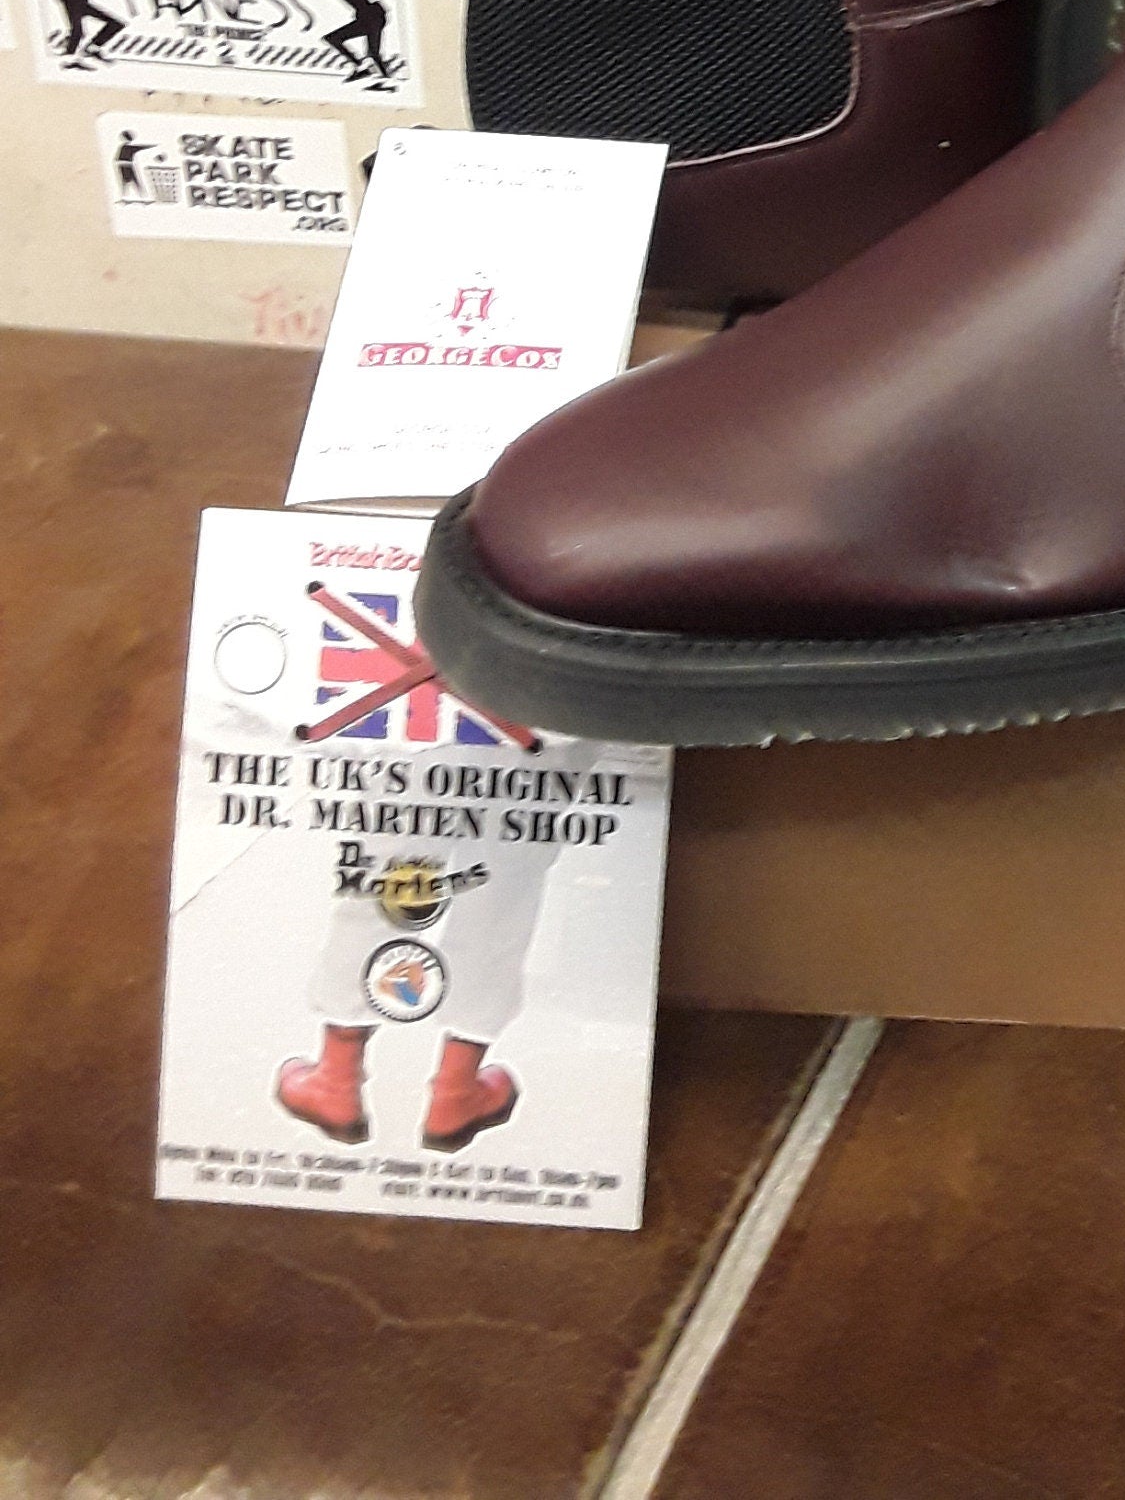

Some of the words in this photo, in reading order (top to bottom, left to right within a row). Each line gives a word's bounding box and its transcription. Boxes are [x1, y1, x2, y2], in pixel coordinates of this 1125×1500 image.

[179, 133, 295, 161] SKATE
[184, 160, 281, 185] PARK
[187, 184, 346, 213] RESPECT
[203, 751, 292, 788] THE
[306, 754, 414, 797] UK'S
[424, 762, 636, 807] ORIGINAL
[218, 793, 291, 829] DR.
[309, 800, 488, 839] MARTEN
[500, 809, 620, 846] SHOP
